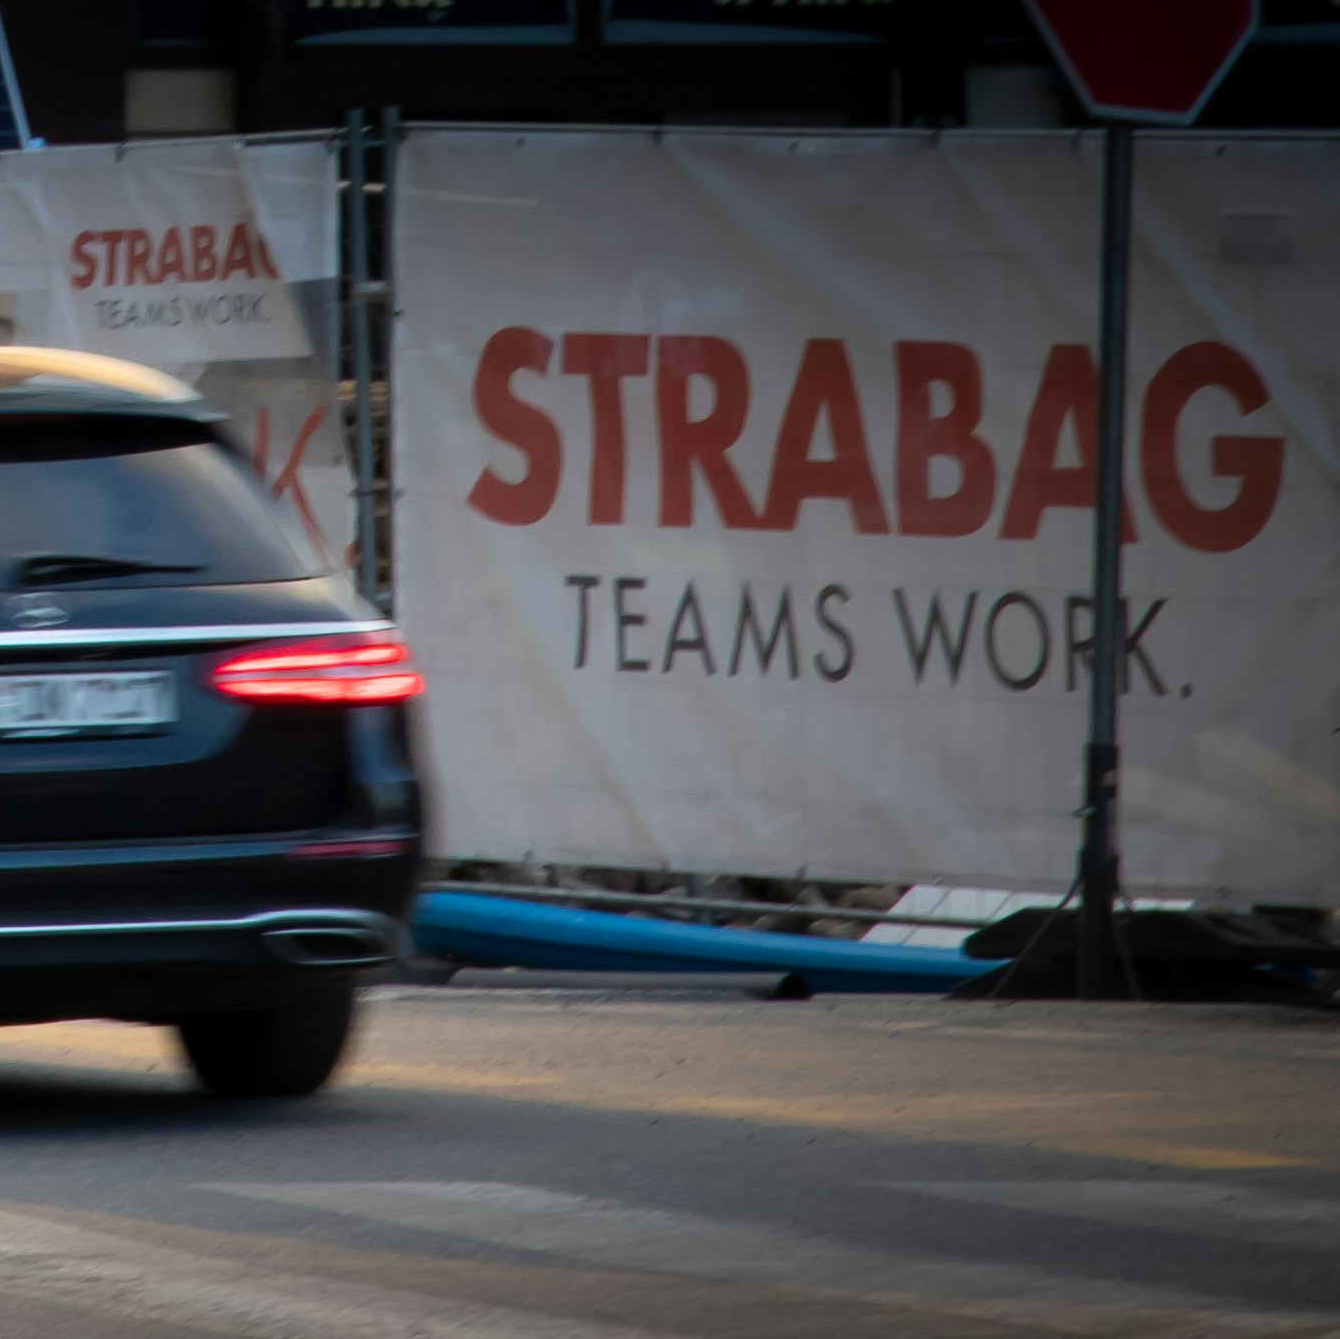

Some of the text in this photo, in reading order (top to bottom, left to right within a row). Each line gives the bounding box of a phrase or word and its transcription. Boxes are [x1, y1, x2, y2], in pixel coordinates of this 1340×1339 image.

[467, 326, 1287, 554] STRABAG
[566, 575, 1195, 699] TEAMS WORK.
